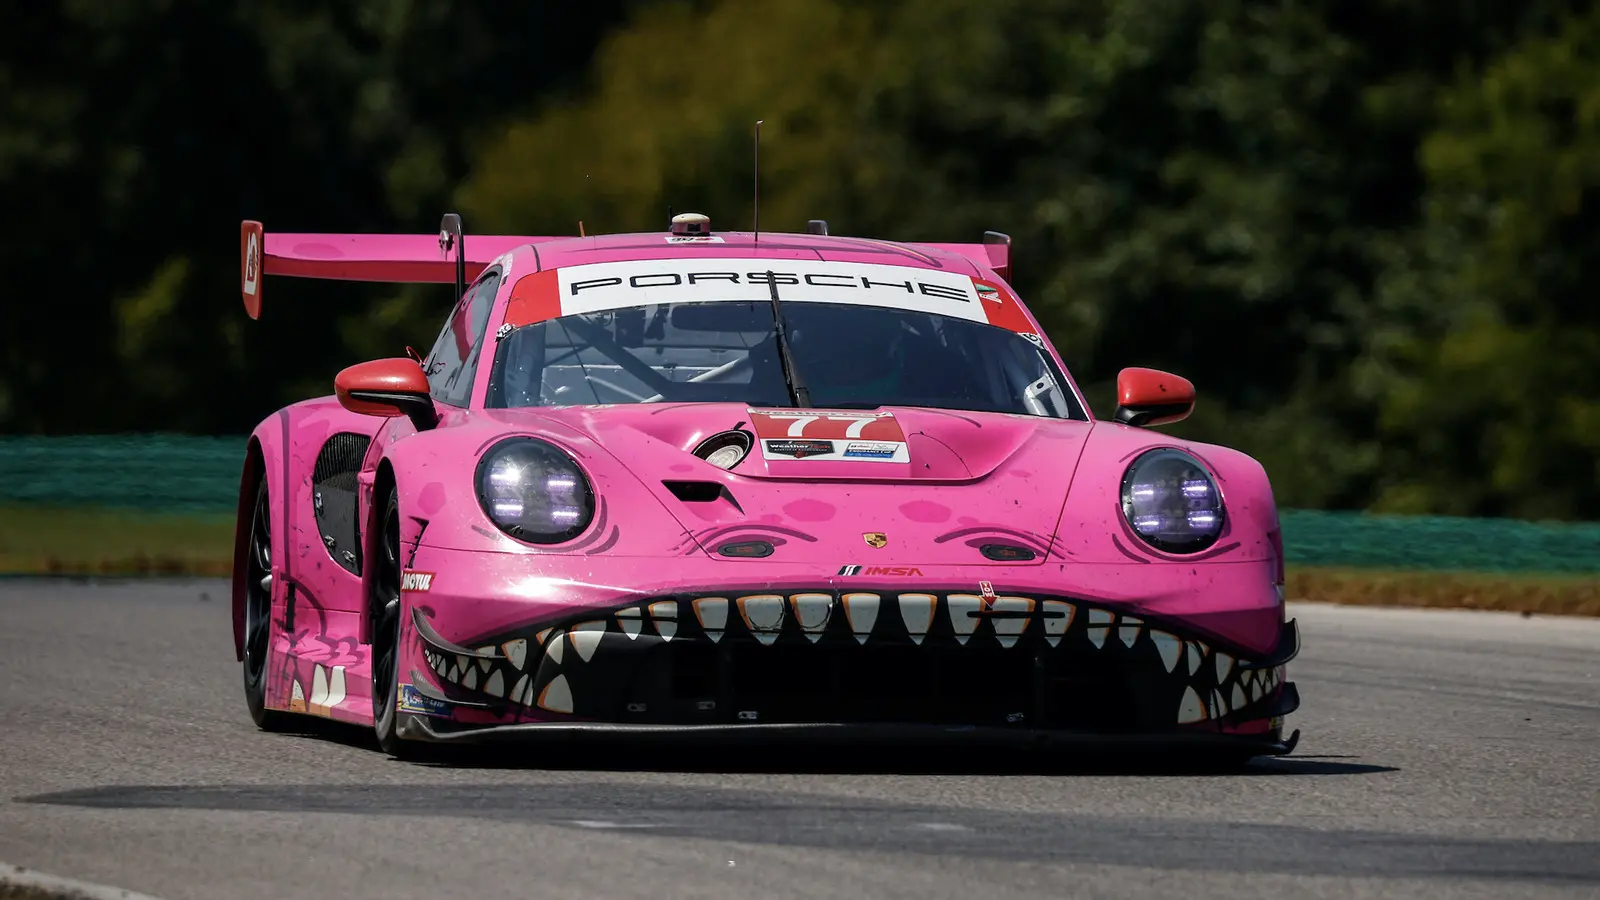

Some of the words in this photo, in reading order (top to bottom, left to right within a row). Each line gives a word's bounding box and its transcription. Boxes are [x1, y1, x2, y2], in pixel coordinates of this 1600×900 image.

[570, 271, 970, 303] PORSCHE
[769, 415, 877, 438] 77
[401, 573, 432, 590] MOTUL
[865, 567, 924, 577] IMSA
